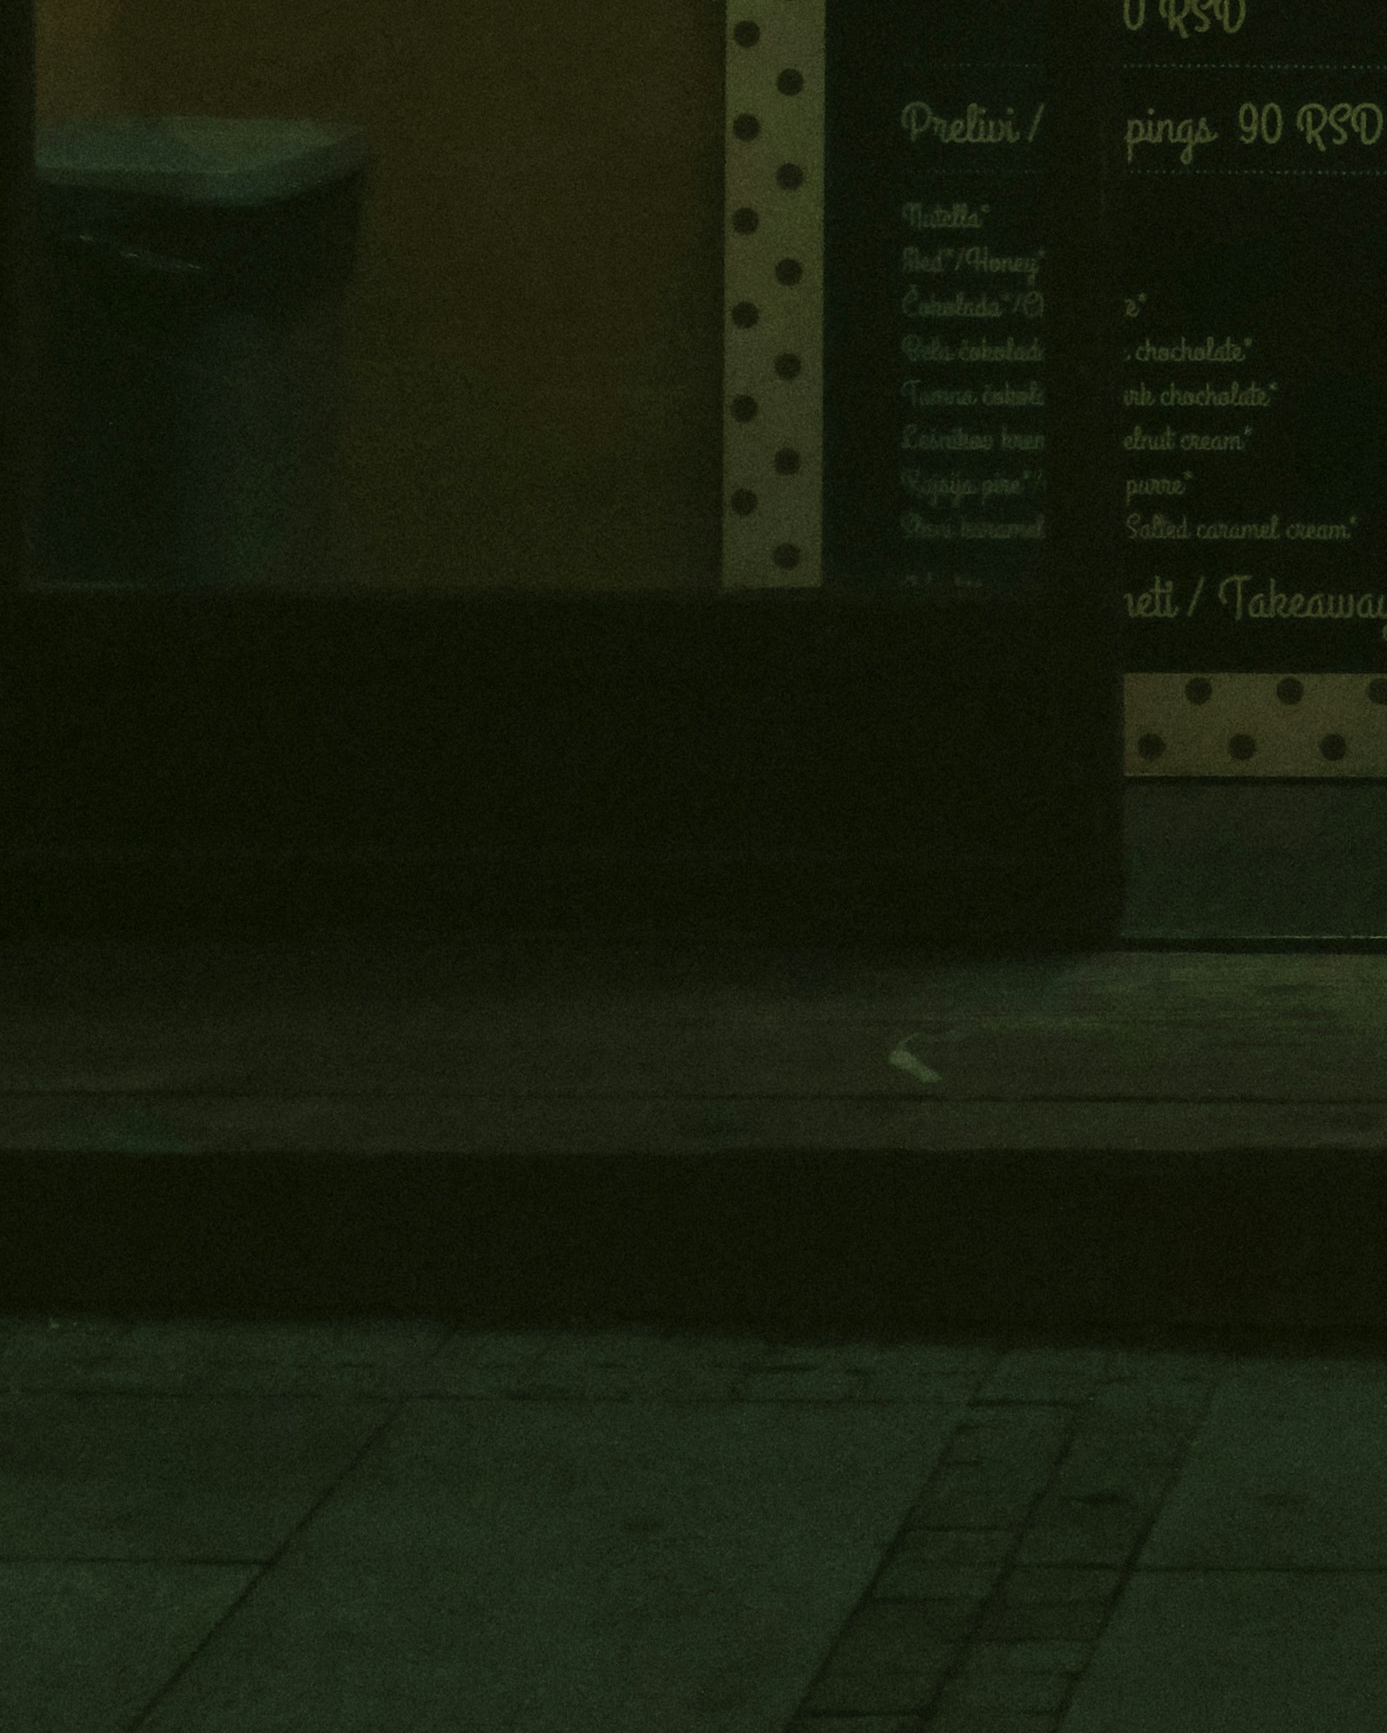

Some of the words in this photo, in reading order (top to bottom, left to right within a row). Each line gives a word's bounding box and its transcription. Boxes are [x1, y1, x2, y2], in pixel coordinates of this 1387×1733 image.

[900, 100, 1021, 145] Prelivi
[1237, 101, 1284, 146] 90
[1295, 101, 1384, 154] RSD
[1125, 511, 1191, 541] Salted
[1195, 512, 1281, 540] caramel
